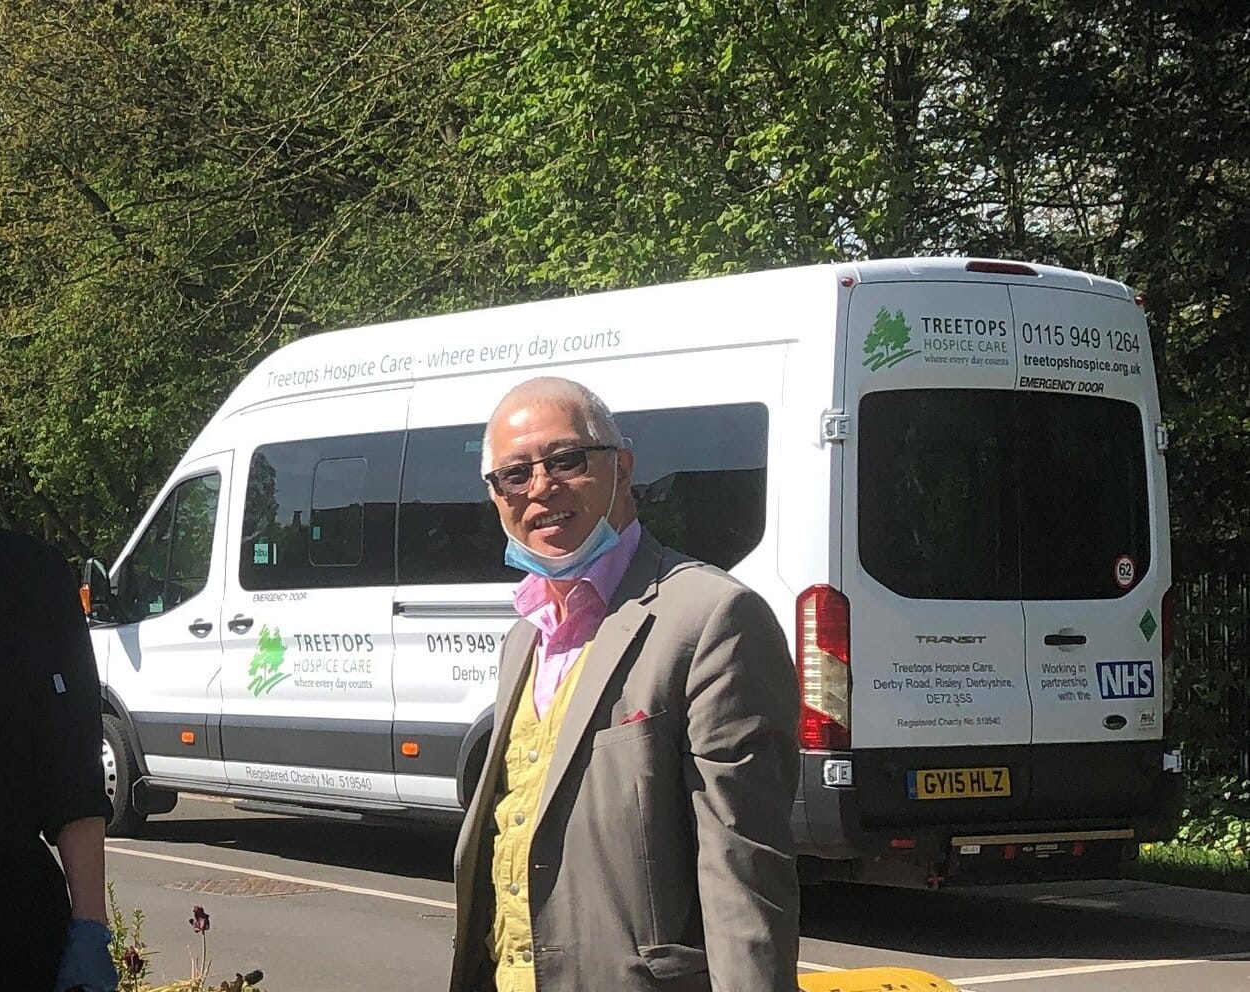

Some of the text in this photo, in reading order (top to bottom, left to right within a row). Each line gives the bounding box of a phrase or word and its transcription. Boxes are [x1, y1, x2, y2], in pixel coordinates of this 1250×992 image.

[921, 317, 1007, 337] TREETOPS
[923, 338, 1007, 353] HOSPICE CARE
[1022, 322, 1140, 354] 0115 949 1264
[268, 328, 621, 388] Treetops Hospice Care where every day counts
[1024, 353, 1141, 377] treetopshospice.org.uk
[1019, 376, 1104, 394] EMERGENCY DOOR
[1119, 562, 1132, 577] 62
[293, 633, 374, 653] TREETOPS
[427, 633, 496, 653] 0115 949
[915, 635, 987, 644] TRANSIT
[293, 659, 372, 674] HOSPICE CARE
[452, 665, 486, 684] Derby
[892, 662, 933, 675] Treetops
[935, 663, 970, 674] Hospice
[1042, 664, 1086, 675] Working in
[873, 679, 903, 690] Derby
[1041, 678, 1088, 690] partnership
[1101, 663, 1153, 697] NHS
[926, 694, 973, 704] DE72 3SS
[1057, 691, 1091, 701] with the
[897, 719, 936, 729] Registered
[245, 766, 289, 783] Registered
[290, 770, 320, 788] Charity
[339, 775, 373, 791] 519540
[924, 770, 1004, 794] GY15 HLZ
